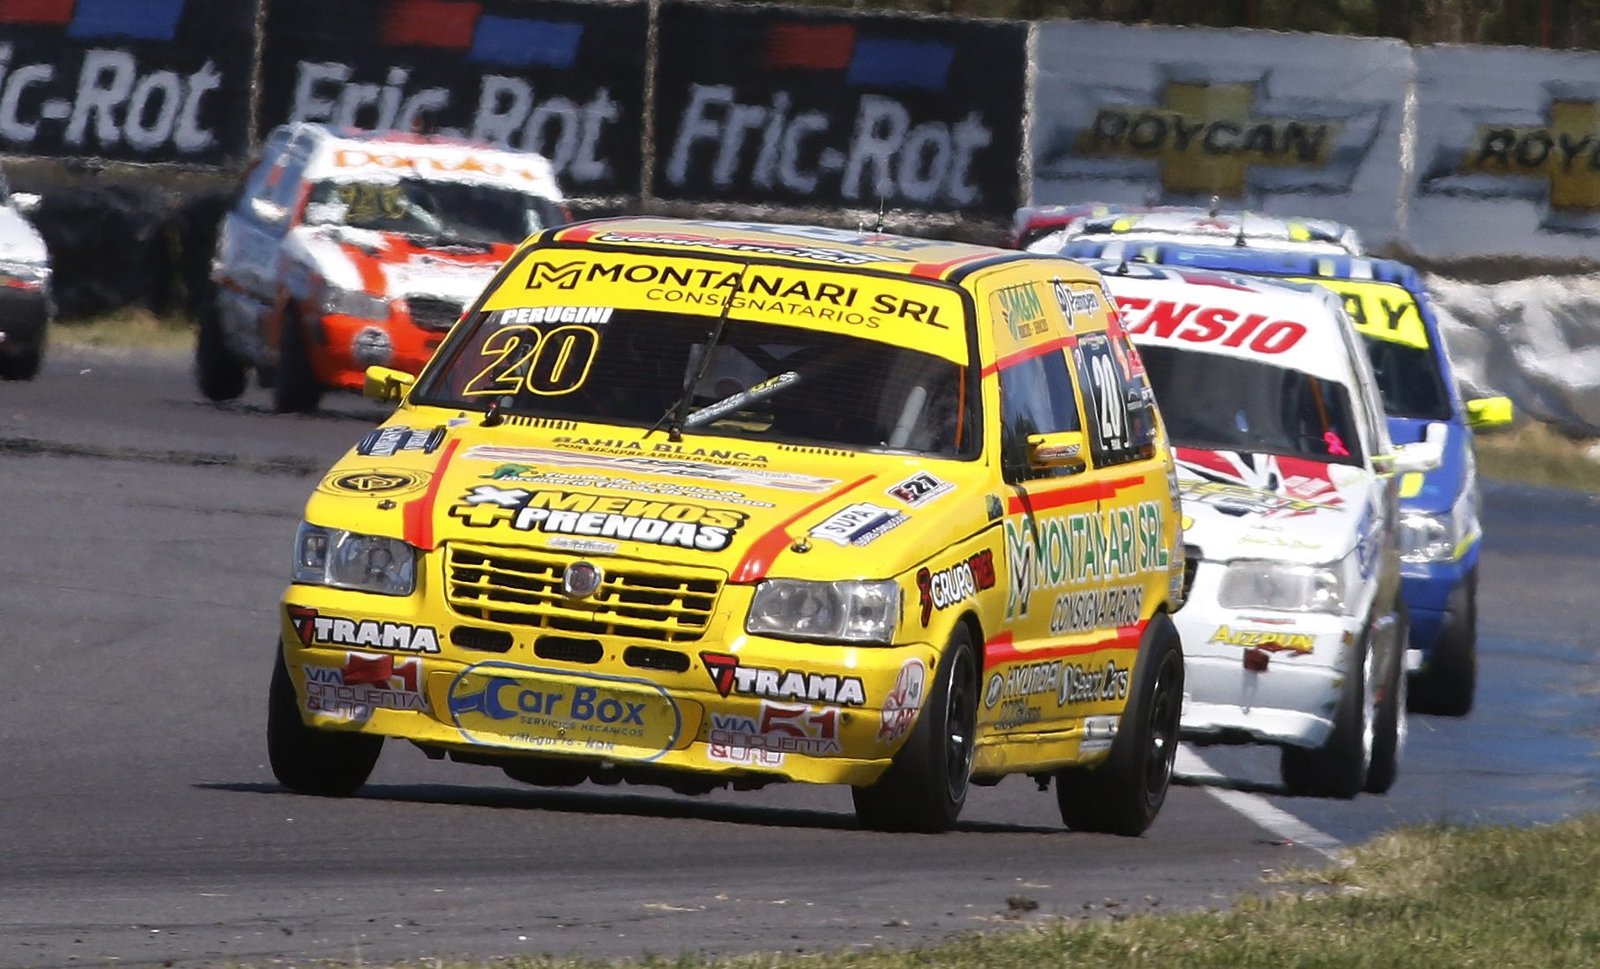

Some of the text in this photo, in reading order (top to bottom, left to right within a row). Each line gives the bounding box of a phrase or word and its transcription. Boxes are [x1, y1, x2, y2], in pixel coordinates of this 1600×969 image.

[666, 82, 993, 203] Fric-Rot
[1092, 107, 1327, 162] ROYCAN
[500, 307, 614, 325] PERUGINI
[585, 262, 858, 307] MONTANARI
[870, 293, 950, 330] SRL
[645, 287, 881, 330] CONSIGNATARIOS
[462, 324, 600, 397] 20
[552, 436, 769, 463] BAHIA BLANCA
[515, 507, 729, 549] PRENDAS
[824, 508, 875, 533] SUPA
[1033, 508, 1137, 588] MONTANARI
[1139, 502, 1169, 570] SRL
[930, 562, 975, 610] GRUPO
[1050, 586, 1142, 633] CONSIGNATARIOS
[314, 616, 440, 652] TRAMA
[305, 666, 342, 683] VIA
[734, 667, 866, 704] TRAMA
[485, 680, 647, 726] Car Box
[714, 704, 836, 739] VIA 51
[710, 729, 839, 753] CINCUENTA
